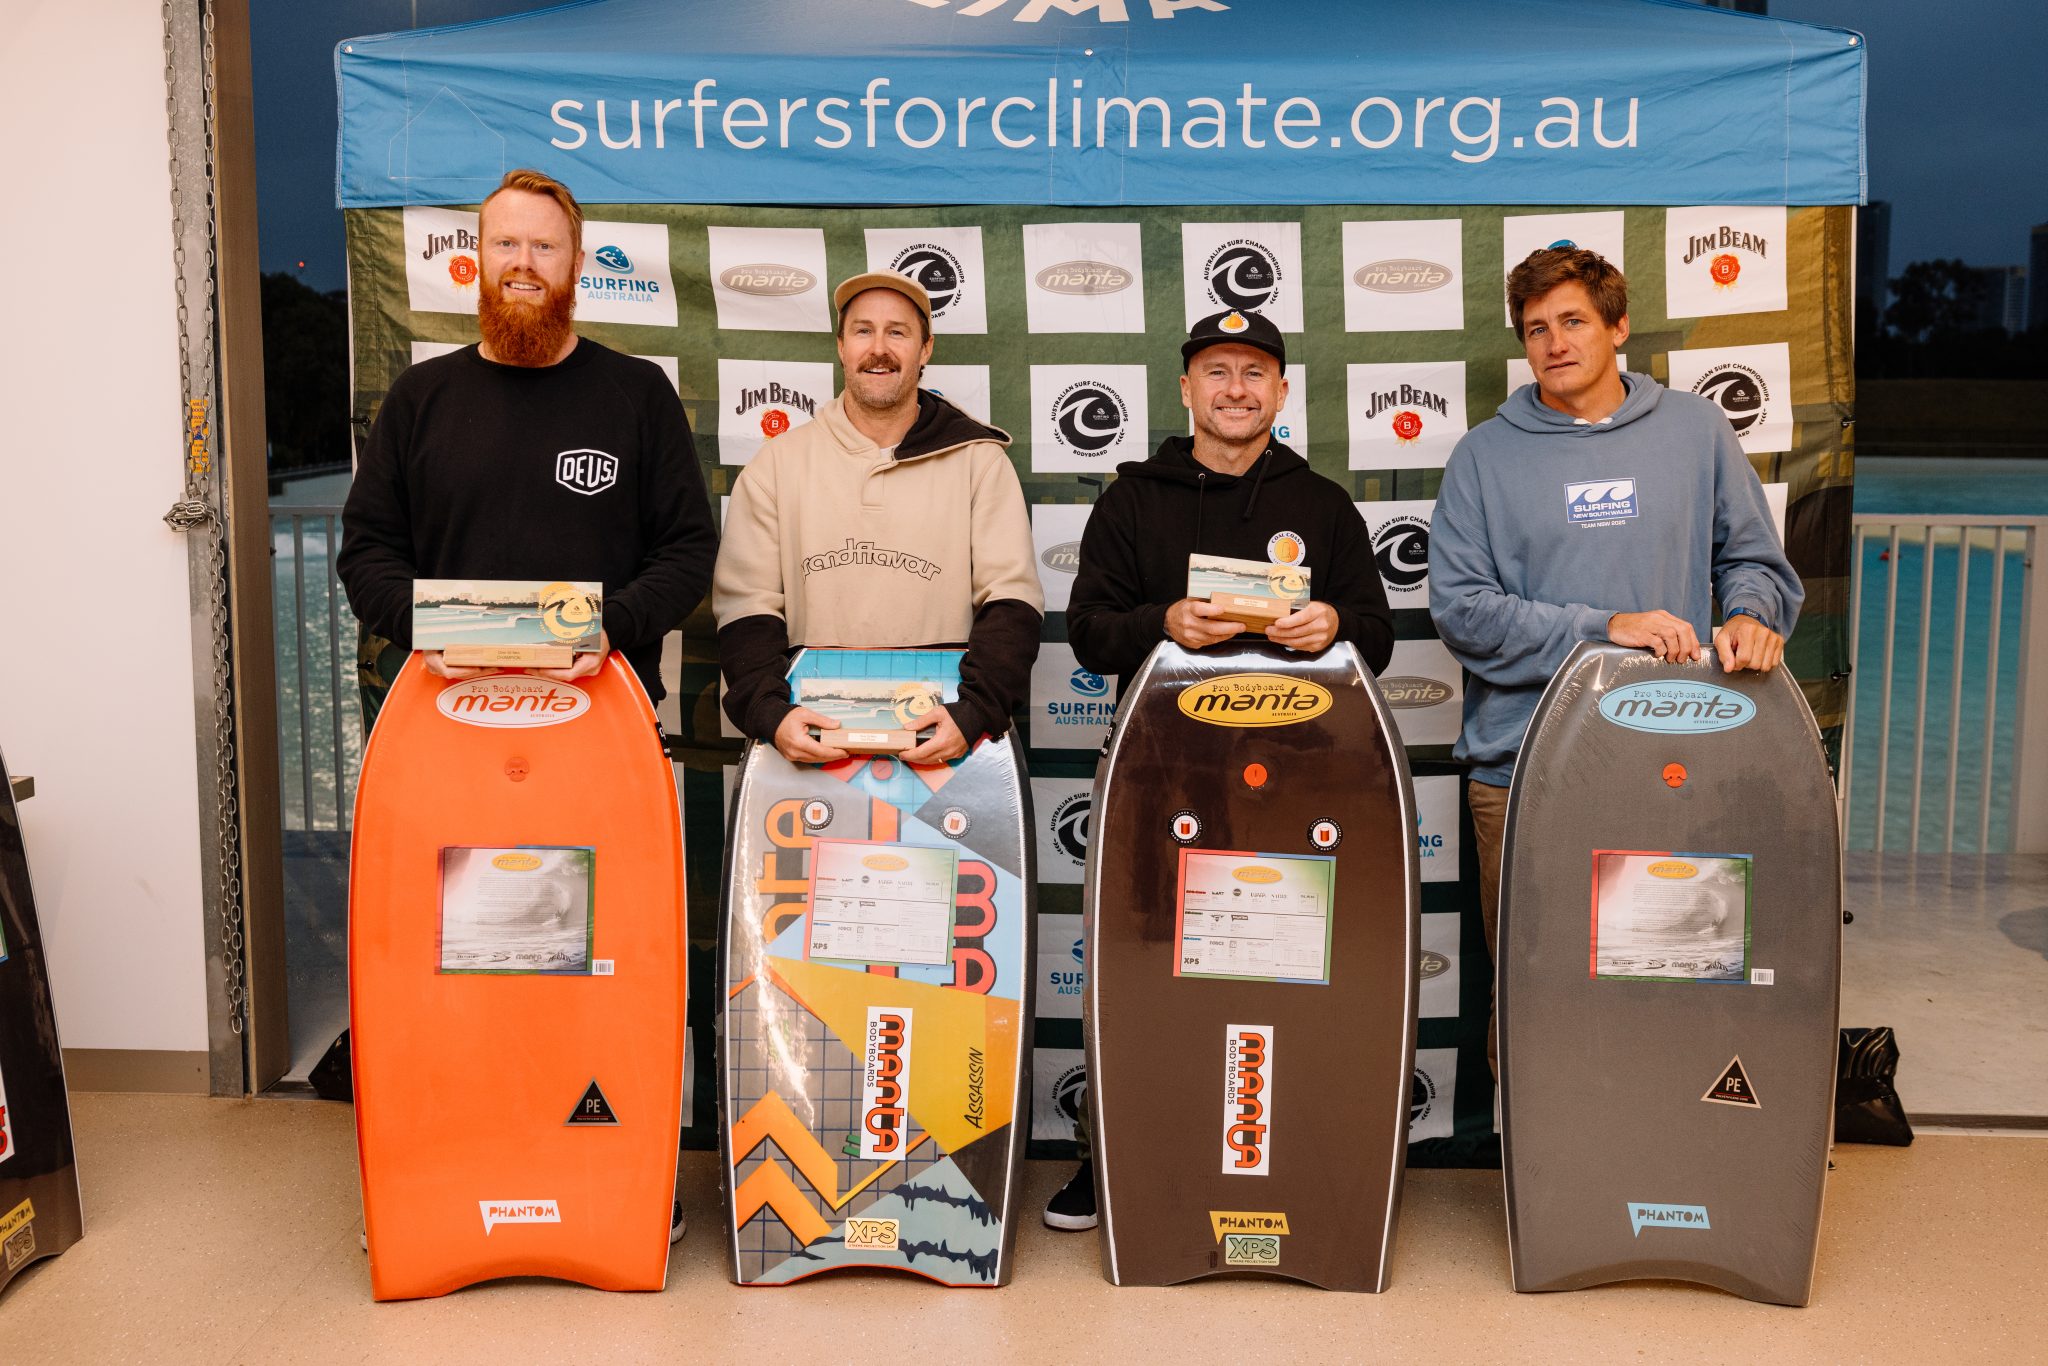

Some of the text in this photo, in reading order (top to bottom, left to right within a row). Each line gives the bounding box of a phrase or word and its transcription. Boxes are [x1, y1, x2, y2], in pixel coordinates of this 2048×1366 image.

[550, 77, 1639, 164] surfersforclimate.org.au
[422, 229, 479, 261] JIM BE
[1683, 226, 1767, 265] JIM BEAM
[889, 242, 966, 285] TRALIAN SURF CHAMPIONSHIPS
[1203, 239, 1283, 281] AUSTRALIAN SURF CHAMPIONSHIPS
[580, 276, 660, 293] SURFING
[729, 268, 811, 289] manta
[1045, 267, 1126, 287] manta
[1363, 267, 1445, 285] manta
[587, 290, 654, 303] AUSTRALIA
[1692, 363, 1770, 402] TRALIAN SURF CHAMPIONSHIPS
[736, 382, 816, 418] JIM BEAM
[1051, 380, 1129, 422] AUSTRALIAN SURF CHAMPIONSHIPS
[1365, 384, 1448, 420] JIM BEAM
[1073, 449, 1108, 458] BODYBOARD
[1573, 500, 1631, 513] SURFING
[1610, 508, 1633, 516] WALES
[1392, 516, 1408, 524] SURF
[1271, 532, 1303, 546] COAL COAST
[1388, 584, 1423, 593] BODYBOARD
[493, 685, 544, 694] Bodyboard
[1194, 686, 1320, 712] manta
[1212, 684, 1285, 693] Pro Bodyboard
[1634, 690, 1708, 700] Pro Bodyboard
[452, 688, 578, 712] manta
[1048, 702, 1117, 716] SURFIN
[1614, 694, 1743, 720] manta
[1050, 792, 1090, 832] AUSTRALIAN SURF
[866, 1021, 878, 1088] BODYBOARDS
[1228, 1039, 1237, 1105] BODYBOARDS
[865, 1014, 906, 1153] manta
[964, 1046, 984, 1130] ASSASSIN
[1052, 1067, 1075, 1100] AUSTRALIAN
[1726, 1077, 1742, 1093] PE
[586, 1098, 601, 1114] PE
[1226, 1032, 1267, 1168] manta
[490, 1206, 556, 1218] PHANTOM
[1220, 1217, 1284, 1228] PHANTOM
[1638, 1208, 1705, 1222] PHANTOM
[848, 1220, 897, 1244] XPS
[1228, 1238, 1278, 1260] XPS
